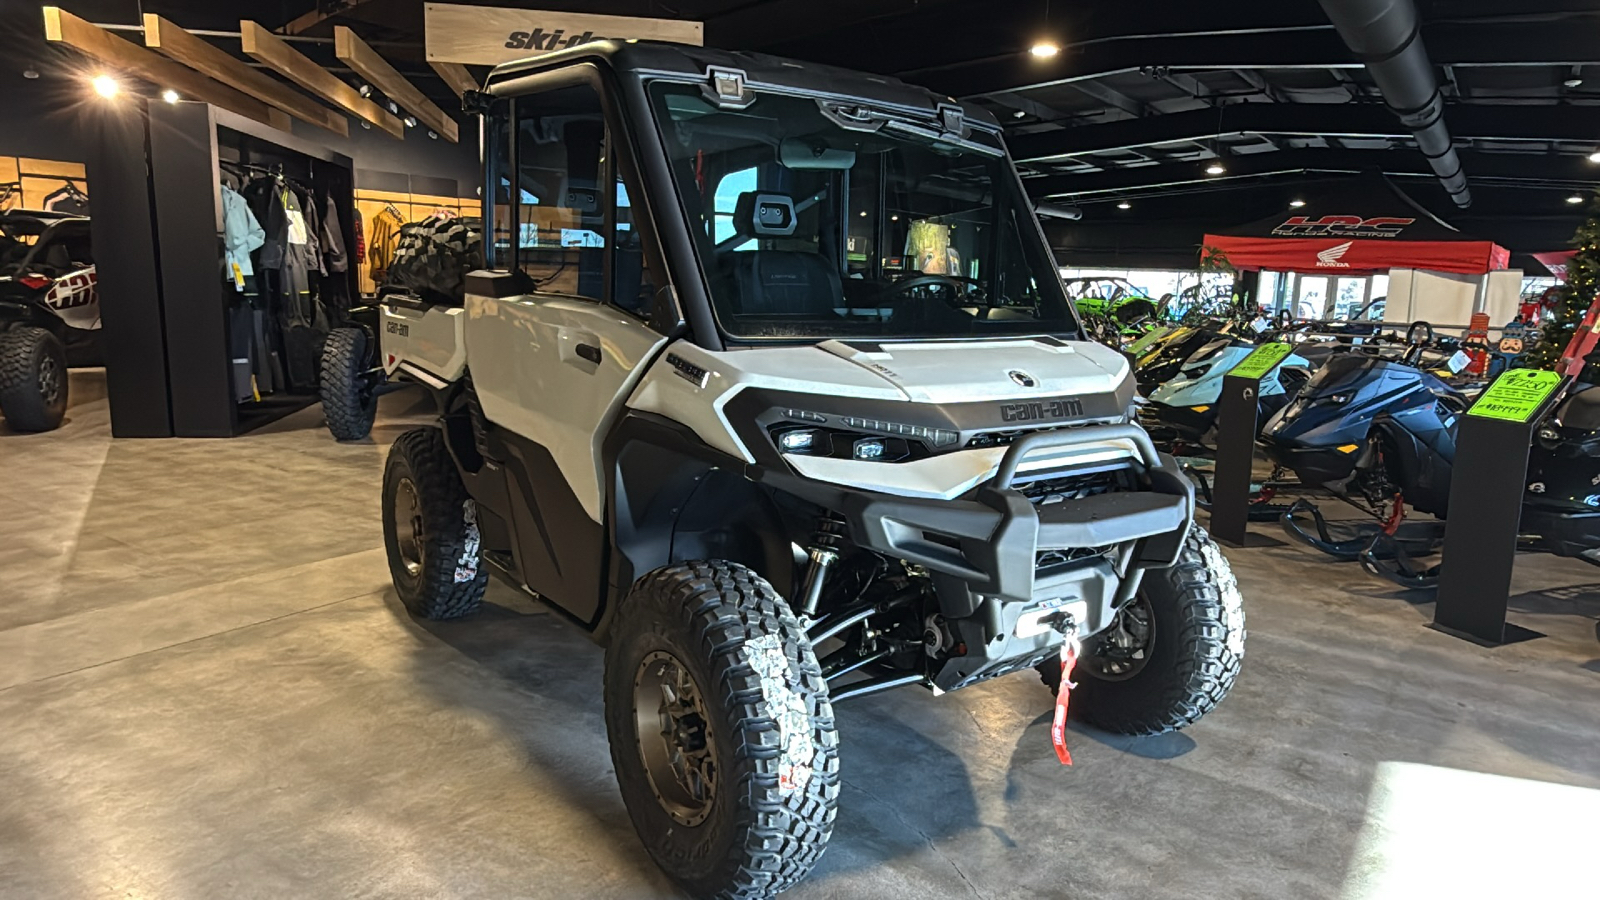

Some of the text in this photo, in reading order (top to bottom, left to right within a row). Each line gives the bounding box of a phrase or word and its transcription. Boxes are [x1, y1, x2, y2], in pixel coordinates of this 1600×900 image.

[504, 28, 626, 51] ski-d
[386, 321, 409, 338] can-am
[1000, 399, 1084, 421] can-am
